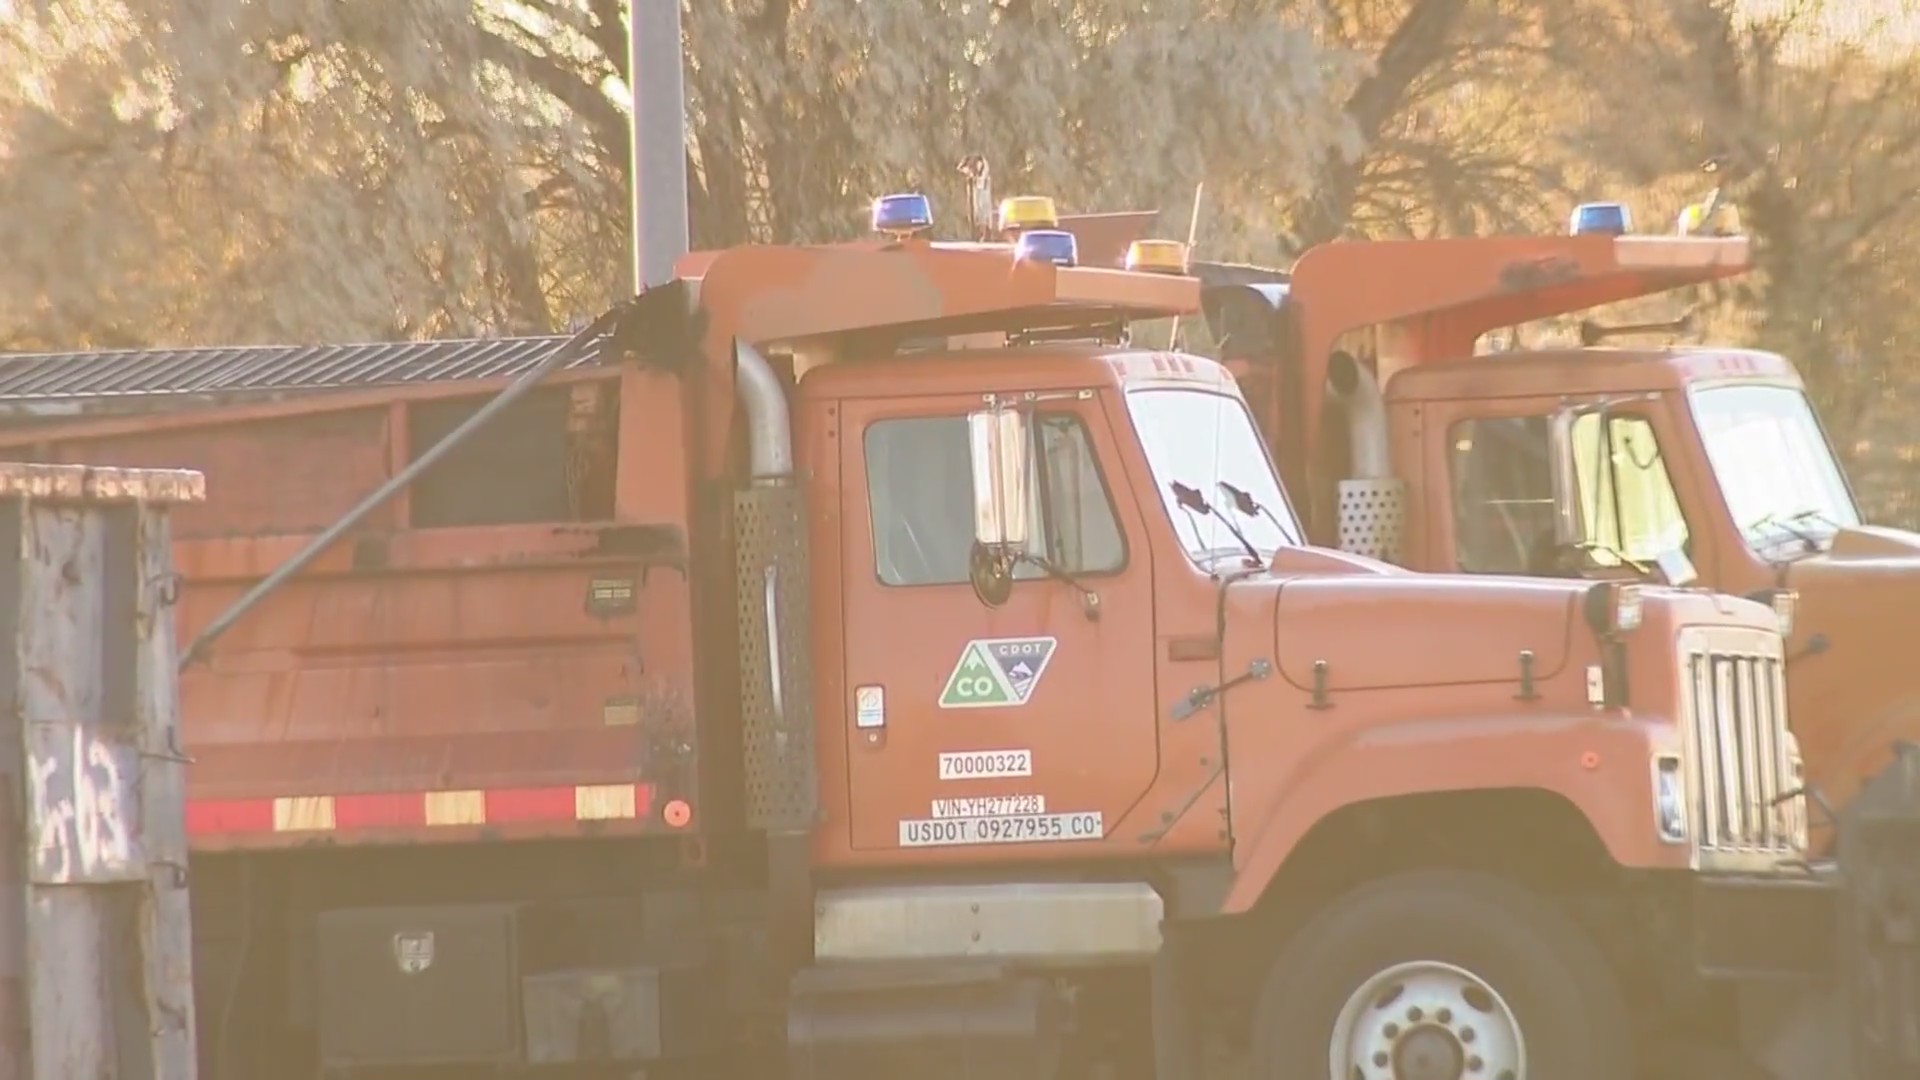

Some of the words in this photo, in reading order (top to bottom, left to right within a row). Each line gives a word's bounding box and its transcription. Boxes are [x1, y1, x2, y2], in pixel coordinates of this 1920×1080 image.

[999, 643, 1042, 655] CDOT
[956, 676, 993, 697] CO
[943, 753, 1027, 775] 70000322
[908, 821, 967, 842] USDOT
[977, 816, 1062, 839] 0927955
